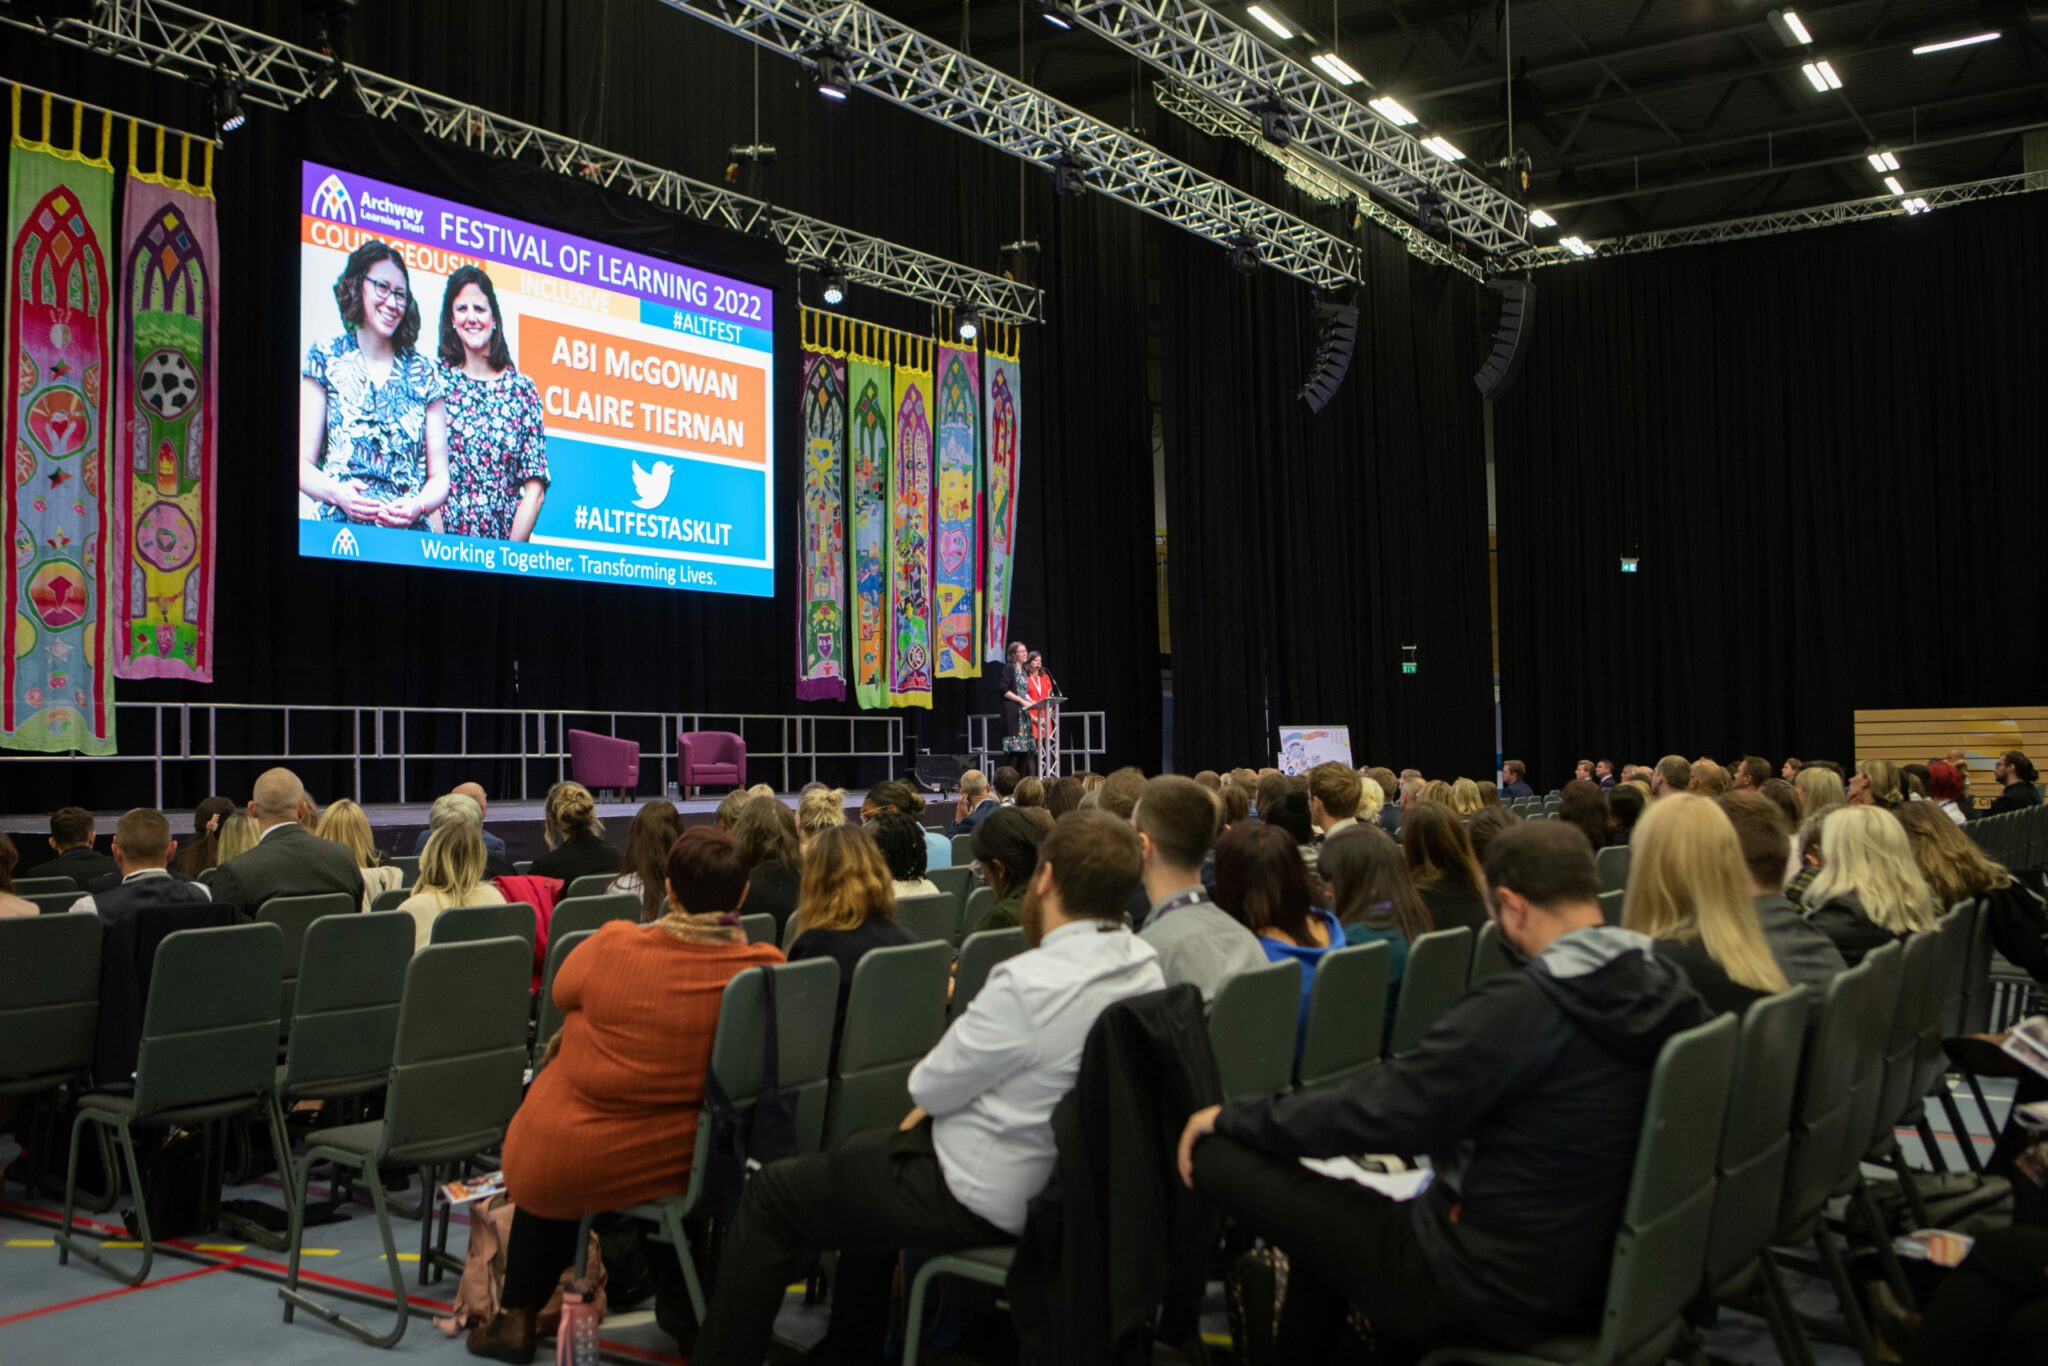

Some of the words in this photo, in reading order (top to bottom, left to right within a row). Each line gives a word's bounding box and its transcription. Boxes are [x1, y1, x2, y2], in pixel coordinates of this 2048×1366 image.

[360, 192, 423, 225] Archway
[360, 208, 401, 231] Learning
[402, 219, 425, 234] Trust
[440, 212, 554, 269] FESTIVAL
[559, 245, 591, 276] OF
[598, 254, 707, 307] LEARNING
[713, 286, 762, 321] 2022
[520, 272, 611, 314] INCLUSIVE
[673, 311, 743, 344] #ALTFEST
[551, 336, 597, 373] ABI
[605, 347, 738, 401] McGOWAN
[545, 385, 634, 429] CLAIRE
[640, 402, 744, 448] TIERNAN
[575, 505, 732, 546] #ALTFESTASKLIT
[421, 538, 495, 569] Working
[499, 547, 574, 572] Together.
[578, 554, 676, 585] Transforming
[680, 565, 717, 585] Lives.
